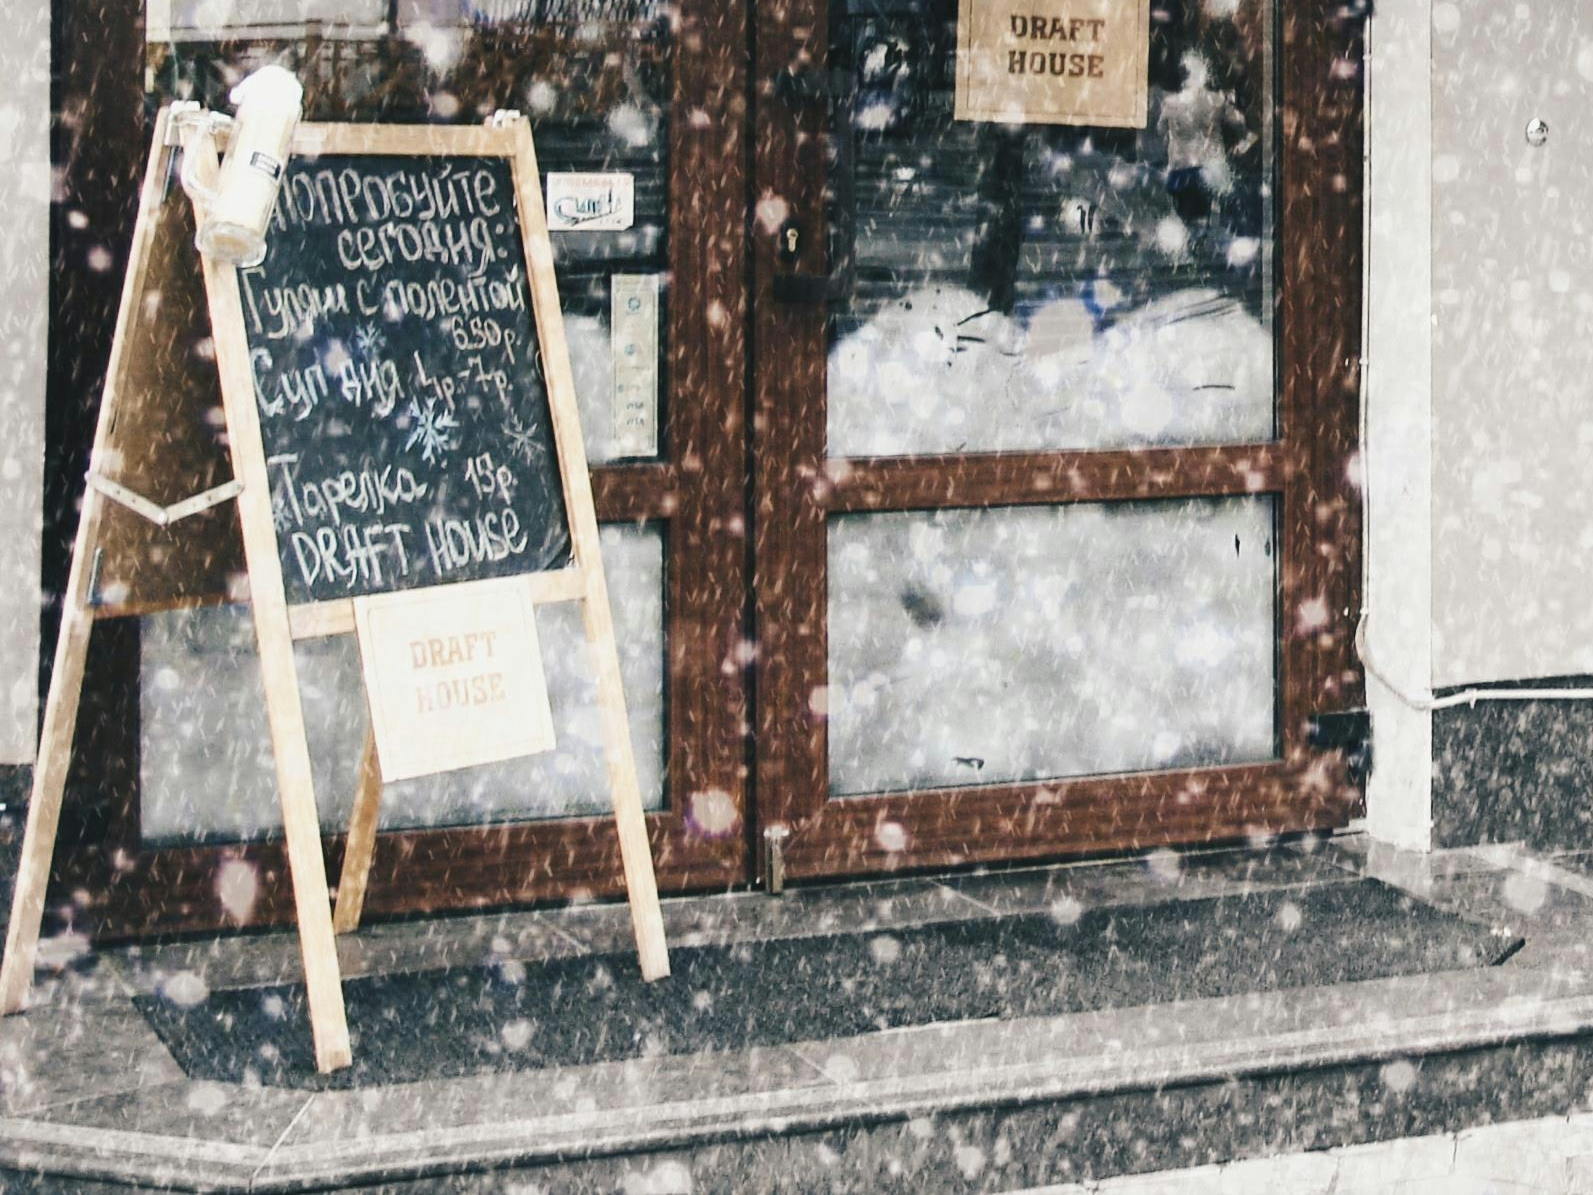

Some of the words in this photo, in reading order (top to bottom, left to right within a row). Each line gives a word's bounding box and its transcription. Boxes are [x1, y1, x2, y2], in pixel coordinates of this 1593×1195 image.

[1010, 14, 1105, 43] DRAFT
[1008, 50, 1104, 79] HOUSE
[267, 453, 428, 526] Тарелка
[291, 523, 411, 589] DRAFT
[409, 630, 497, 670] DRAFT
[416, 673, 506, 714] HOUSE
